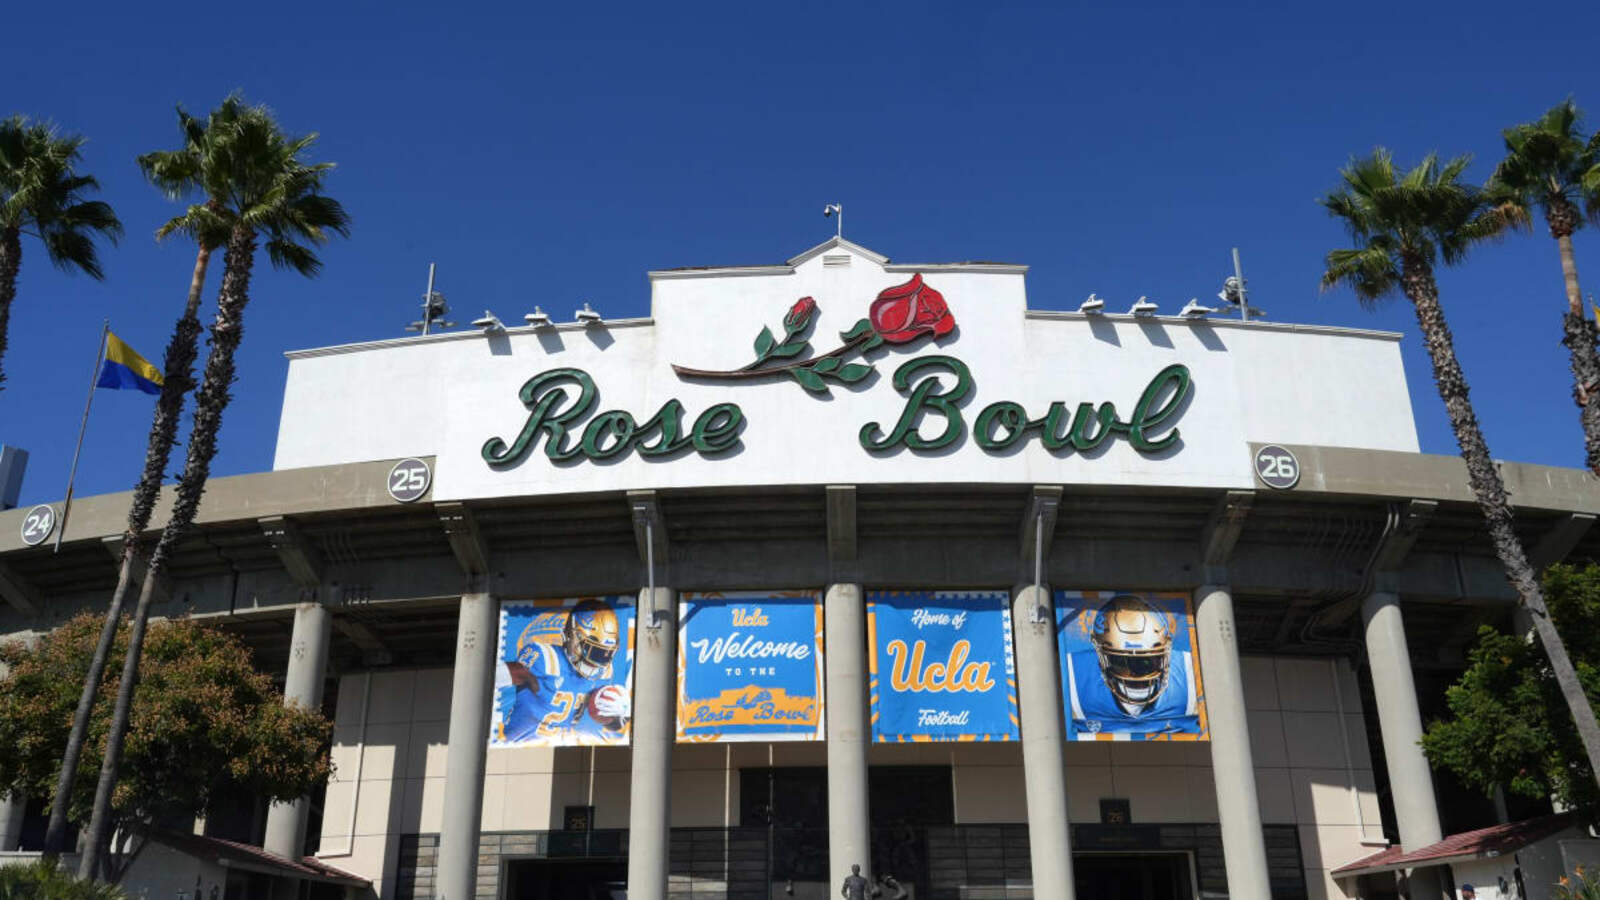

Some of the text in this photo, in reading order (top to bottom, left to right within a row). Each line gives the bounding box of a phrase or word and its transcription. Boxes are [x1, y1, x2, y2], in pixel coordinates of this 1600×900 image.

[481, 355, 1190, 465] Rose Bowl
[1260, 455, 1294, 478] 26
[391, 467, 426, 492] 25
[24, 513, 50, 537] 24
[731, 607, 769, 627] Ucla
[911, 608, 967, 630] Home of
[690, 631, 811, 664] Welcome
[725, 667, 776, 676] TO THE
[886, 639, 996, 692] Ucla
[689, 697, 815, 724] Rose Bowl
[918, 708, 970, 727] Football
